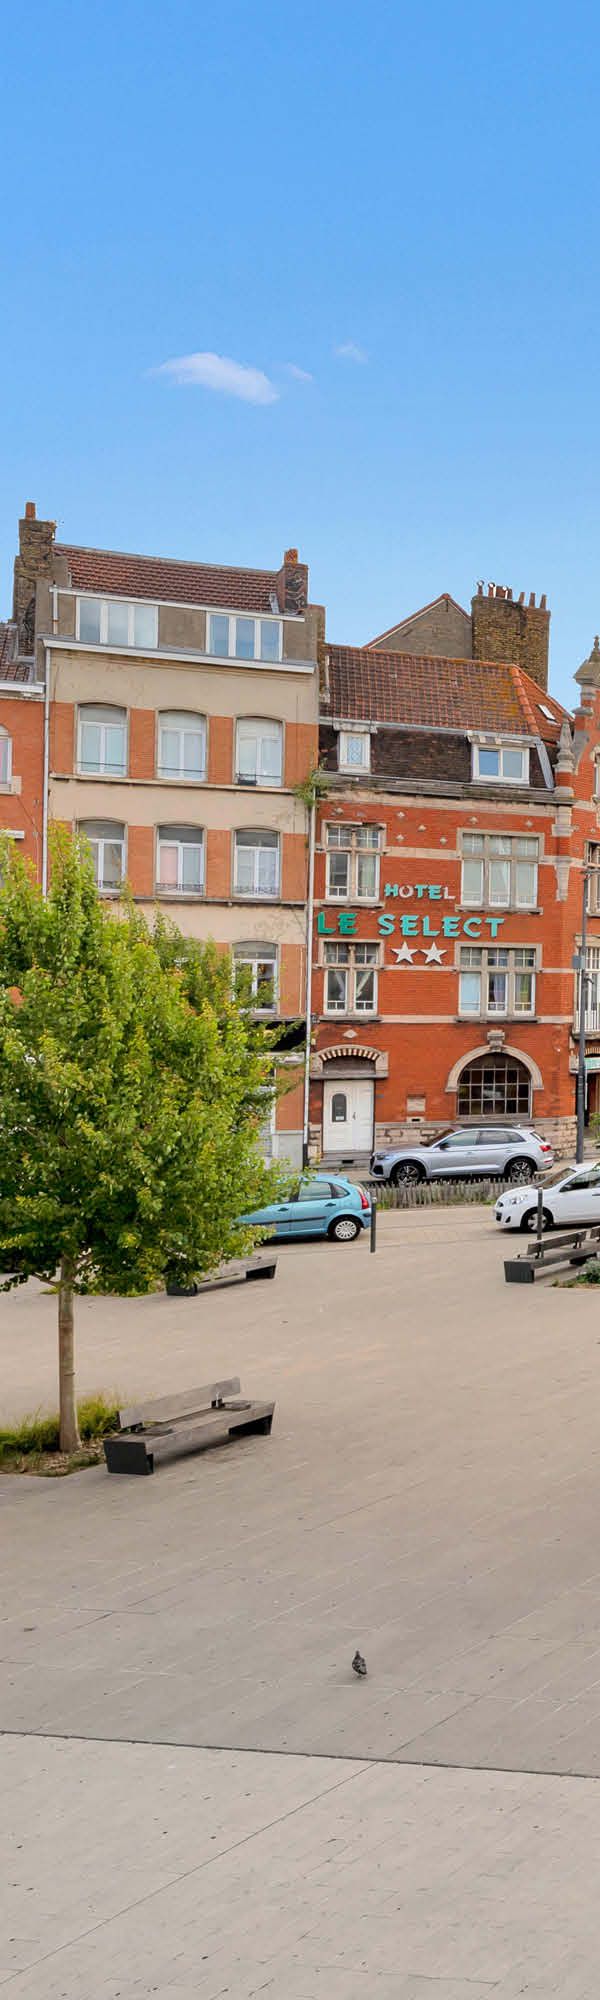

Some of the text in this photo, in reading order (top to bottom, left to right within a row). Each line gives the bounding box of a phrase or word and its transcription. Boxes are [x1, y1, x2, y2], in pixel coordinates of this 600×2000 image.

[384, 883, 456, 900] HOTEL
[317, 911, 505, 938] LE SELECT
